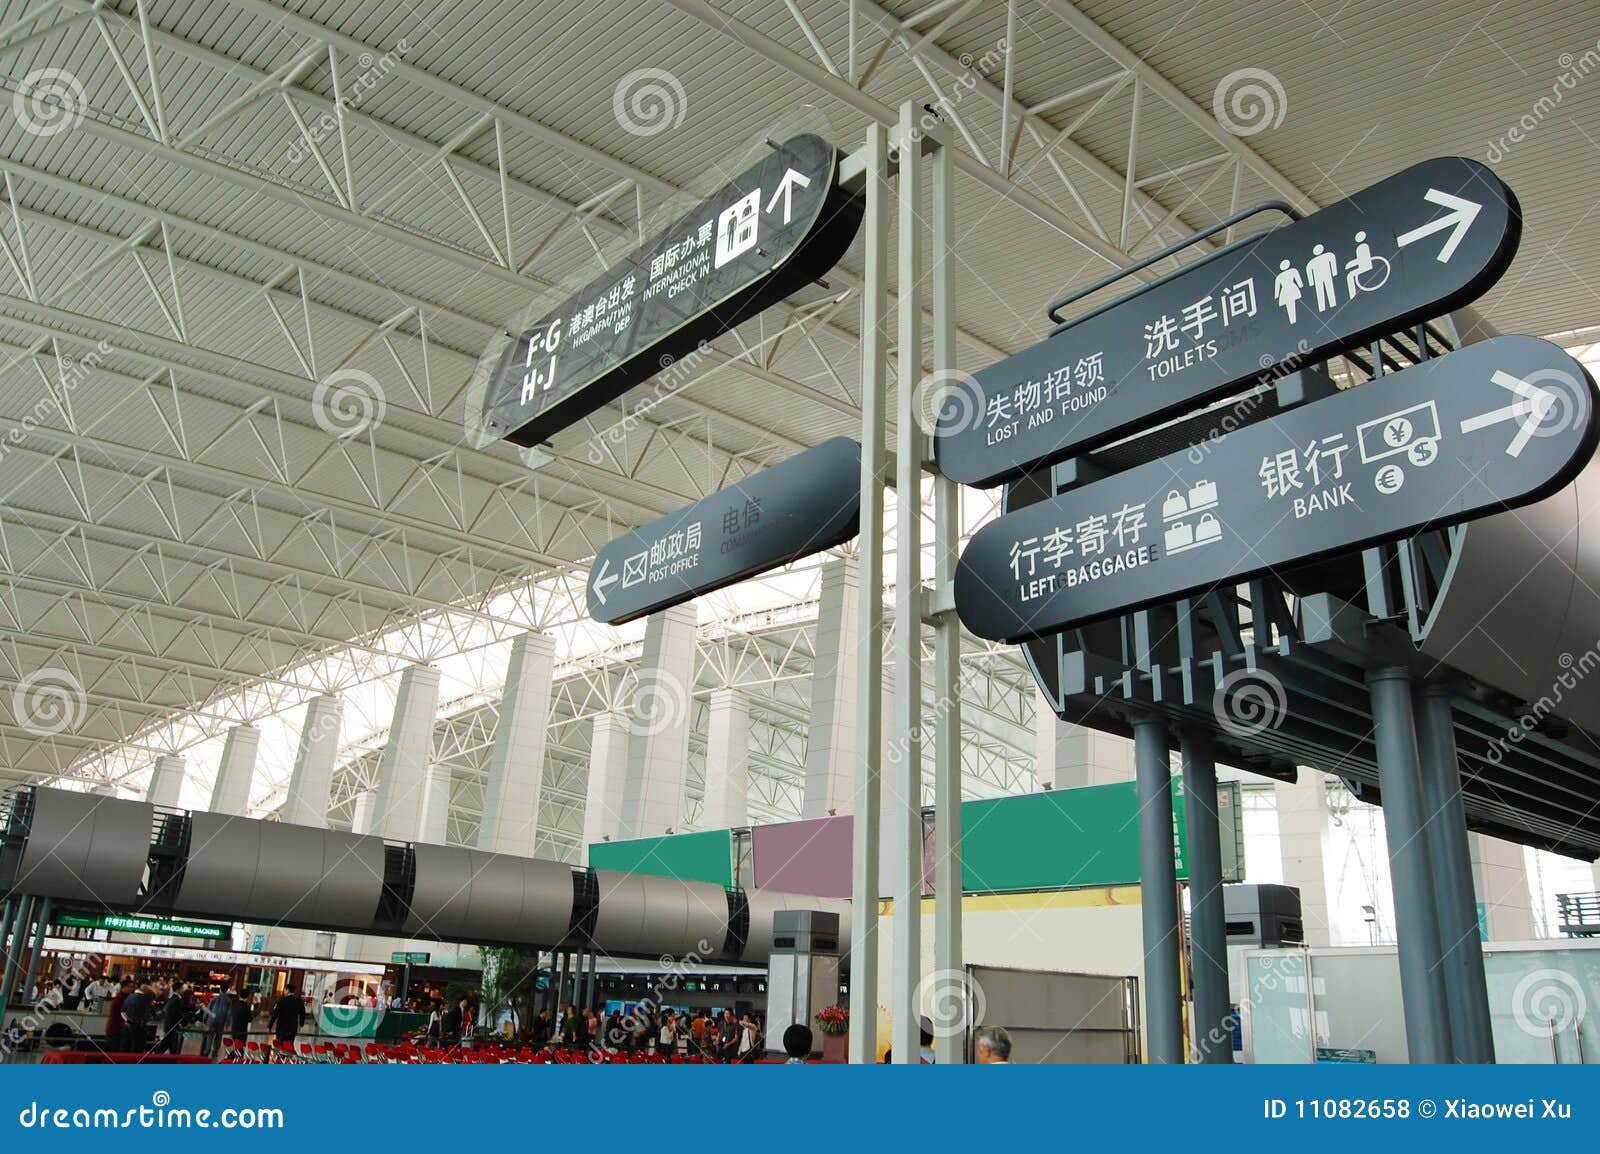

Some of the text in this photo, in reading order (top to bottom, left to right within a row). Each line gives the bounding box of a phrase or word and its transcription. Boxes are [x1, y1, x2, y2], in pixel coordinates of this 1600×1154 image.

[643, 249, 710, 302] INTERNATIONAL
[649, 219, 714, 282] 国际办票
[569, 275, 636, 336] 港澳台出发
[668, 262, 710, 298] CHECK IN
[614, 315, 630, 335] DEP
[1143, 277, 1257, 359] 洗手间
[1147, 340, 1218, 381] TOILETS
[986, 351, 1105, 428] 失物招领
[987, 386, 1107, 446] LOST AND FOUND
[1258, 432, 1349, 499] 银行
[1293, 482, 1355, 519] BANK
[649, 553, 699, 584] POST OFFICE
[650, 521, 702, 569] 邮政局
[1009, 503, 1148, 581] 行李寄存
[1020, 546, 1149, 602] LEFT BAGGAGE
[162, 924, 220, 936] BAGGAGE PACKING
